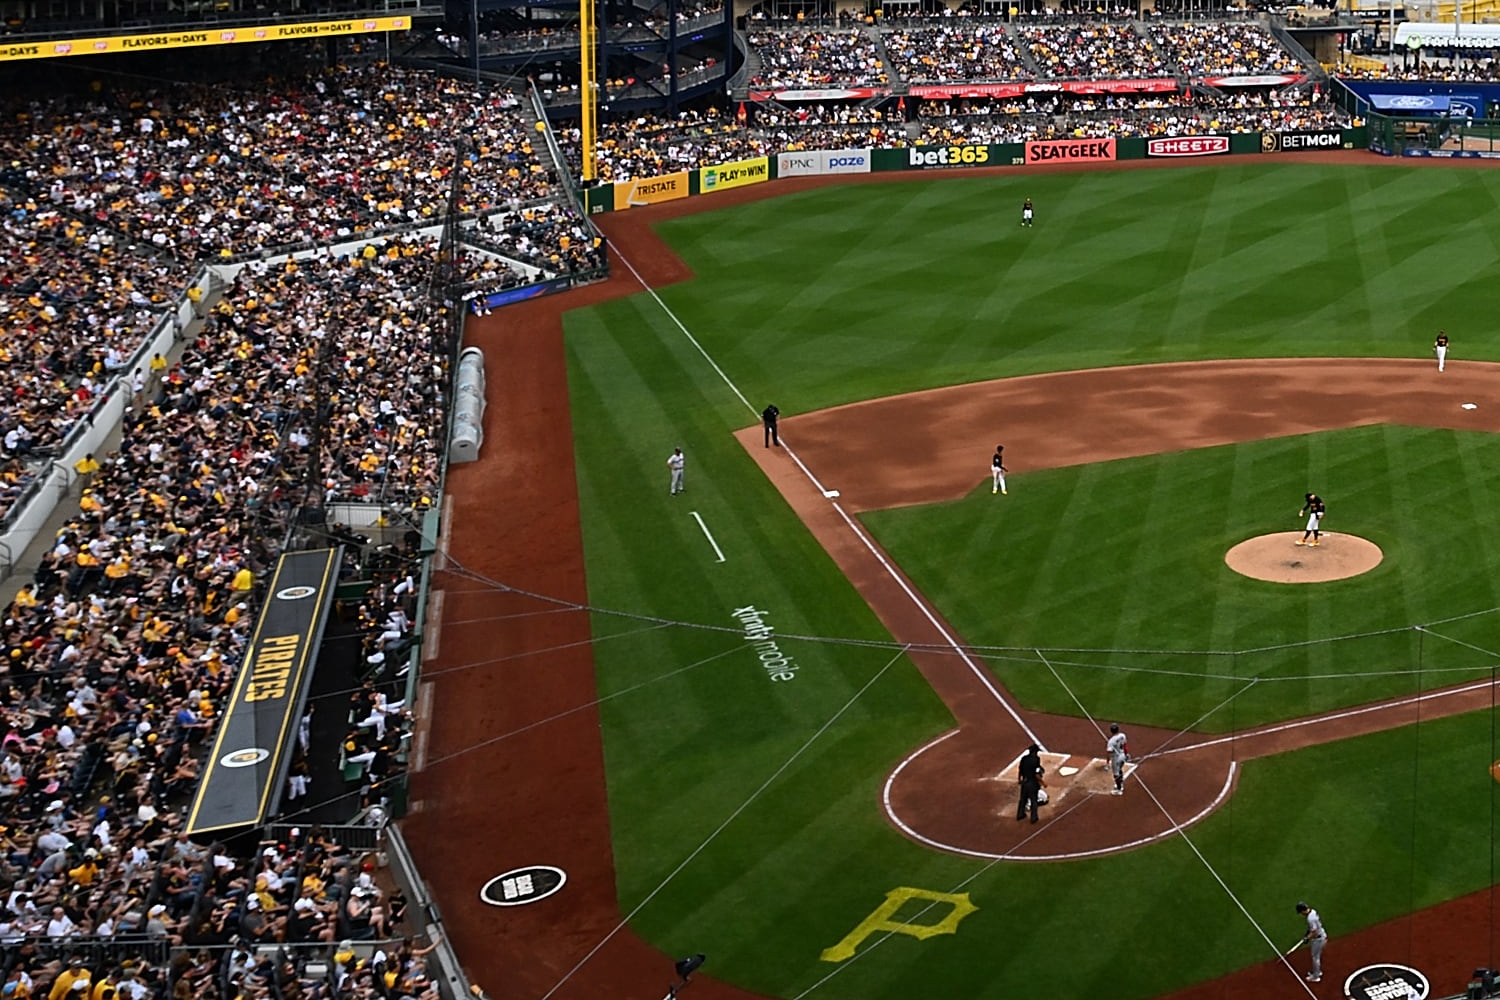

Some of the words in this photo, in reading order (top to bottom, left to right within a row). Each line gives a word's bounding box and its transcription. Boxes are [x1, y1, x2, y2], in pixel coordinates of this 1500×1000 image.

[279, 23, 318, 36] FLAVORS
[331, 24, 352, 32] DAYS
[122, 35, 168, 48] FLAVORS
[182, 34, 207, 43] DAYS
[10, 46, 38, 56] DAYS
[1030, 141, 1111, 161] SEATGEEK
[1154, 139, 1224, 153] SHEETZ
[789, 159, 815, 169] PNC
[829, 156, 865, 170] paze
[909, 145, 989, 166] bet365
[719, 168, 740, 183] PLAY
[747, 164, 766, 178] WIN!
[637, 180, 676, 196] TRISTATE
[731, 605, 774, 640] xfinity
[753, 640, 800, 682] mobile
[244, 633, 300, 703] PIRATES
[819, 886, 980, 962] P
